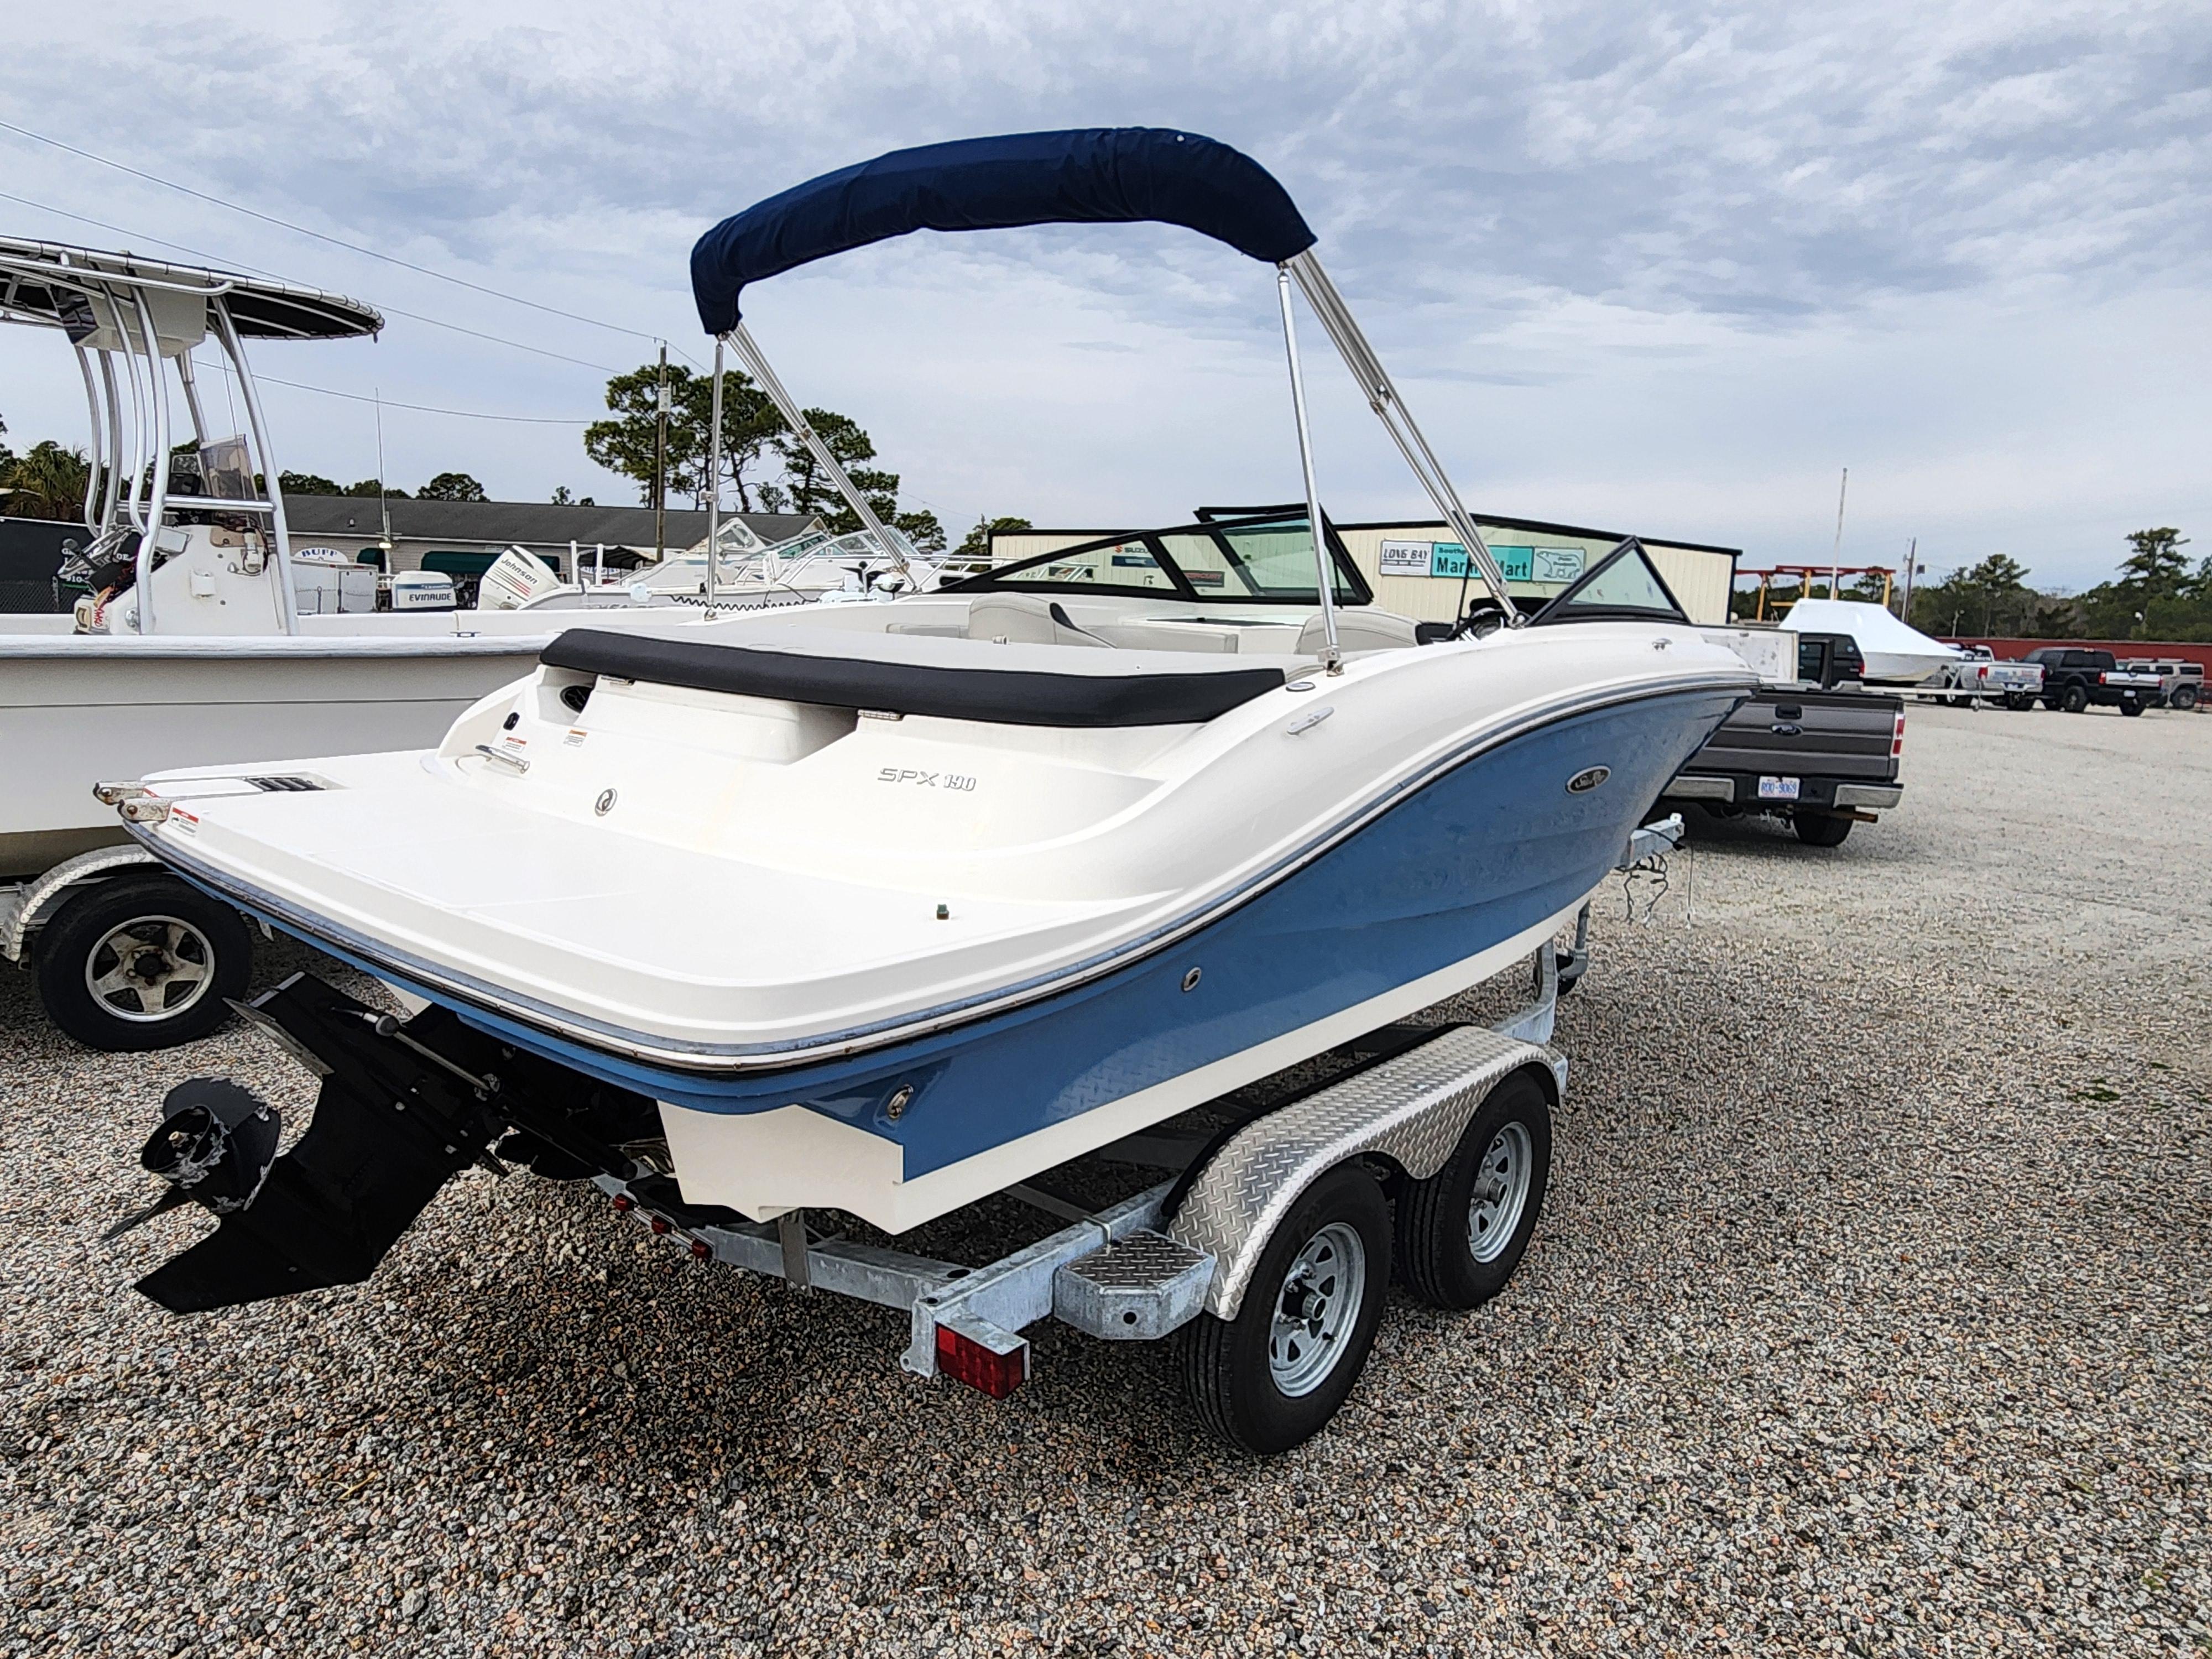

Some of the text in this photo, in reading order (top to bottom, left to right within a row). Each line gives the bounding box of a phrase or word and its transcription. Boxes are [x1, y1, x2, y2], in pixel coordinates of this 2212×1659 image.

[1384, 549, 1429, 560] LONG BAY
[1439, 547, 1469, 555] Southp
[501, 559, 538, 585] Johnson
[1437, 557, 1478, 574] Marn
[409, 592, 452, 602] EVINRUDE
[877, 768, 977, 792] SPX 190
